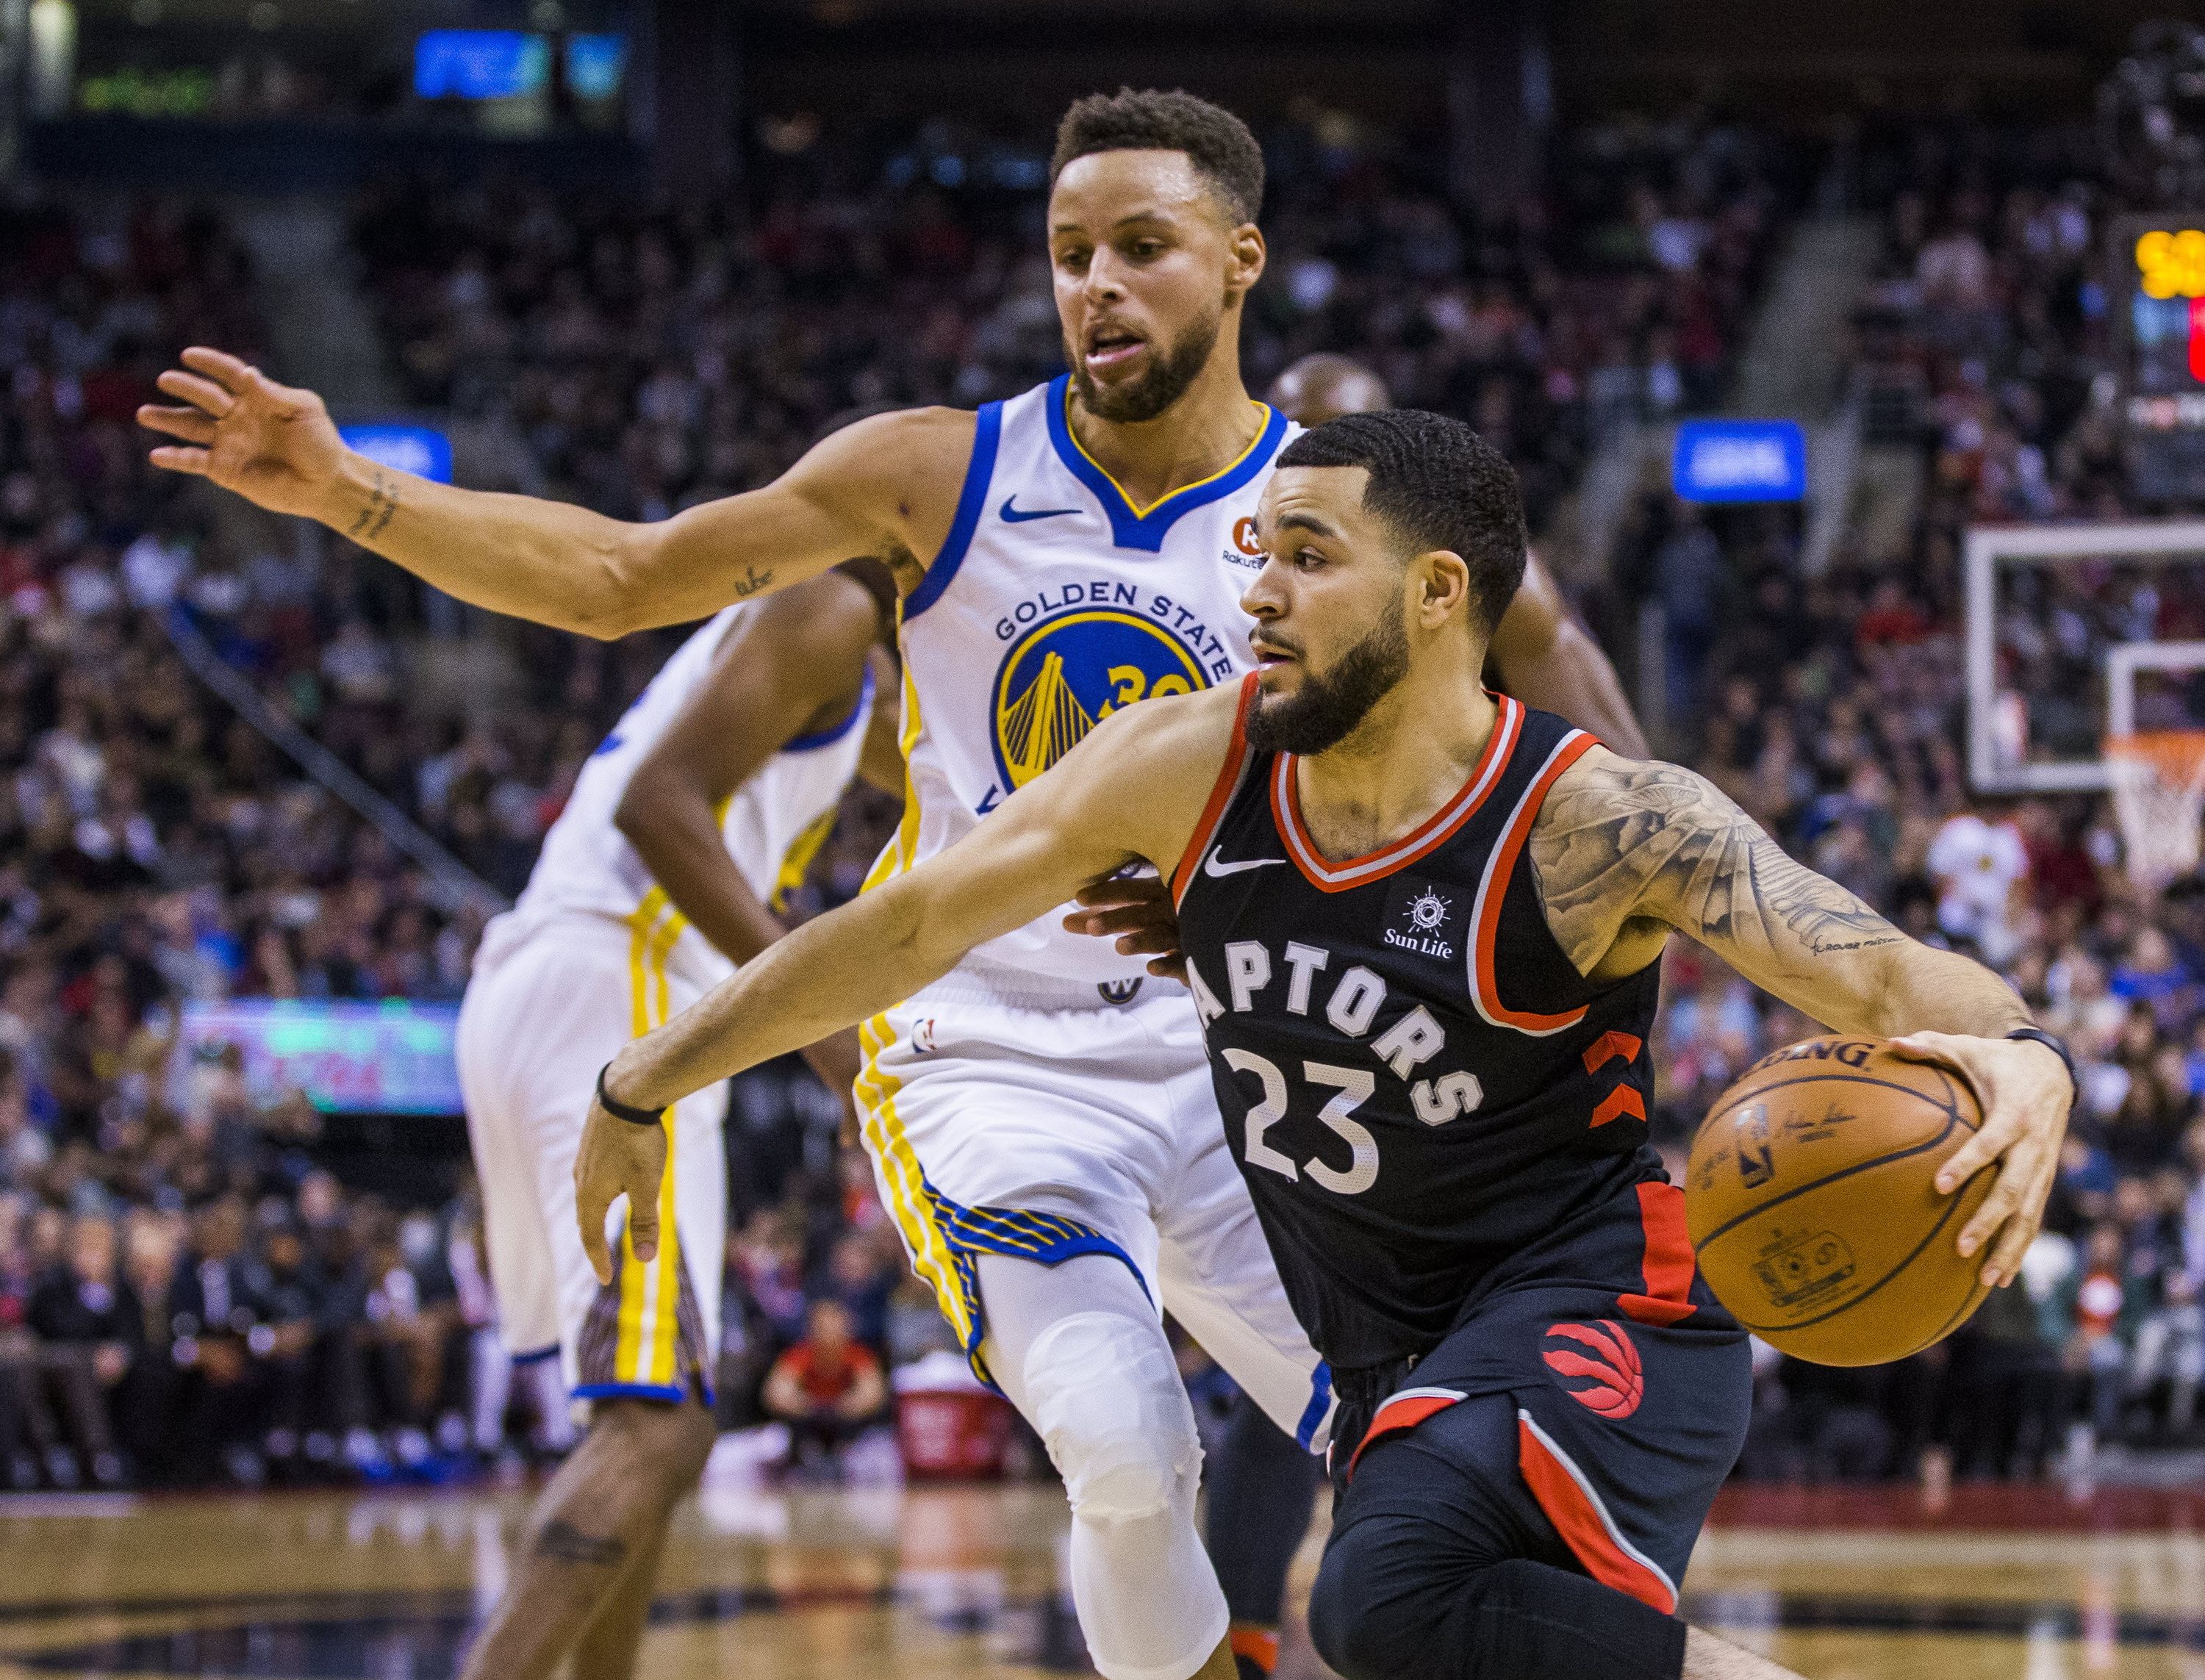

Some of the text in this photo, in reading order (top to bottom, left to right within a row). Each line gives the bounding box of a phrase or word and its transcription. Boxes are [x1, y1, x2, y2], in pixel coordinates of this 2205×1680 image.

[995, 581, 1233, 683] GOLDEN STATE
[1384, 928, 1452, 959] Sun Life
[1186, 939, 1485, 1127] APTORS
[1220, 1047, 1380, 1194] 23
